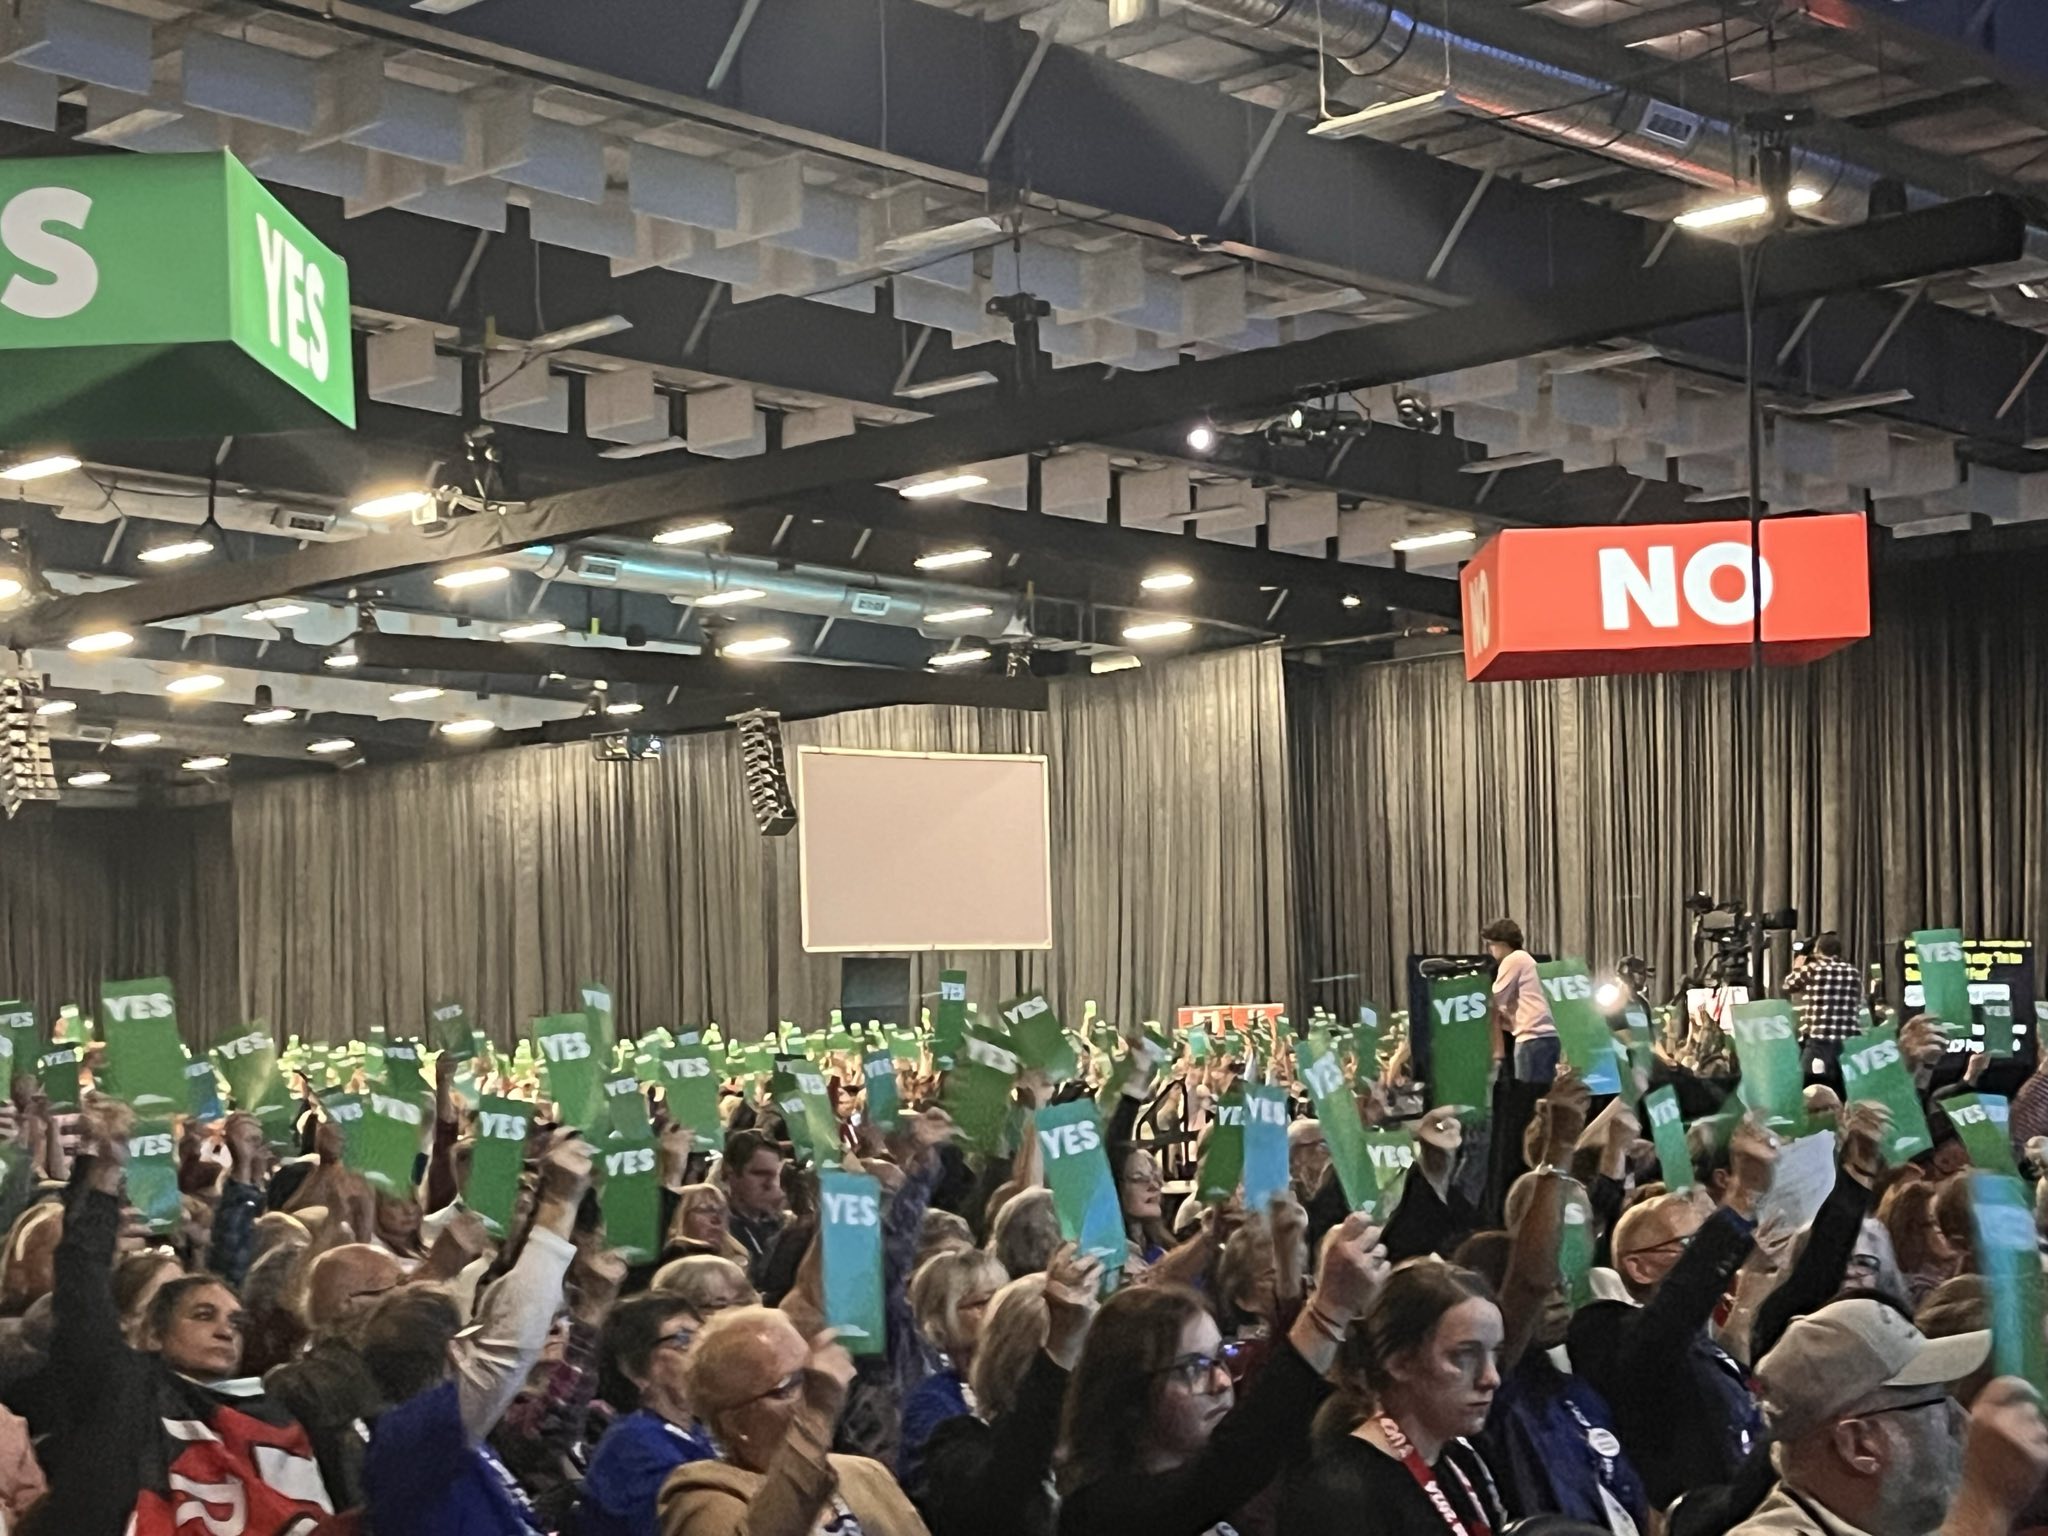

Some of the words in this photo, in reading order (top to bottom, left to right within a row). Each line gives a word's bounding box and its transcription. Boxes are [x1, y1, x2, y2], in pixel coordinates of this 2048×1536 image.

[256, 212, 330, 382] YES
[1599, 541, 1774, 630] NO
[1469, 568, 1490, 659] NO
[1916, 942, 1965, 963] YES
[1542, 974, 1592, 1002] YES
[102, 993, 174, 1022] YES
[1003, 996, 1048, 1024] YES
[1433, 992, 1487, 1025] YES
[1735, 1014, 1792, 1043] YES
[217, 1031, 268, 1059] YES
[538, 1032, 591, 1062] YES
[1851, 1039, 1900, 1075] YES
[664, 1057, 710, 1079] YES
[1304, 1051, 1344, 1099] YES
[1219, 1106, 1246, 1126] YE
[1245, 1093, 1286, 1127] YES
[1648, 1098, 1680, 1127] YES
[1948, 1104, 1987, 1126] YES
[481, 1110, 527, 1141] YES
[1040, 1119, 1100, 1160] YES
[128, 1133, 172, 1157] YES
[1366, 1144, 1414, 1169] YES
[605, 1147, 656, 1177] YES
[824, 1192, 878, 1227] YES
